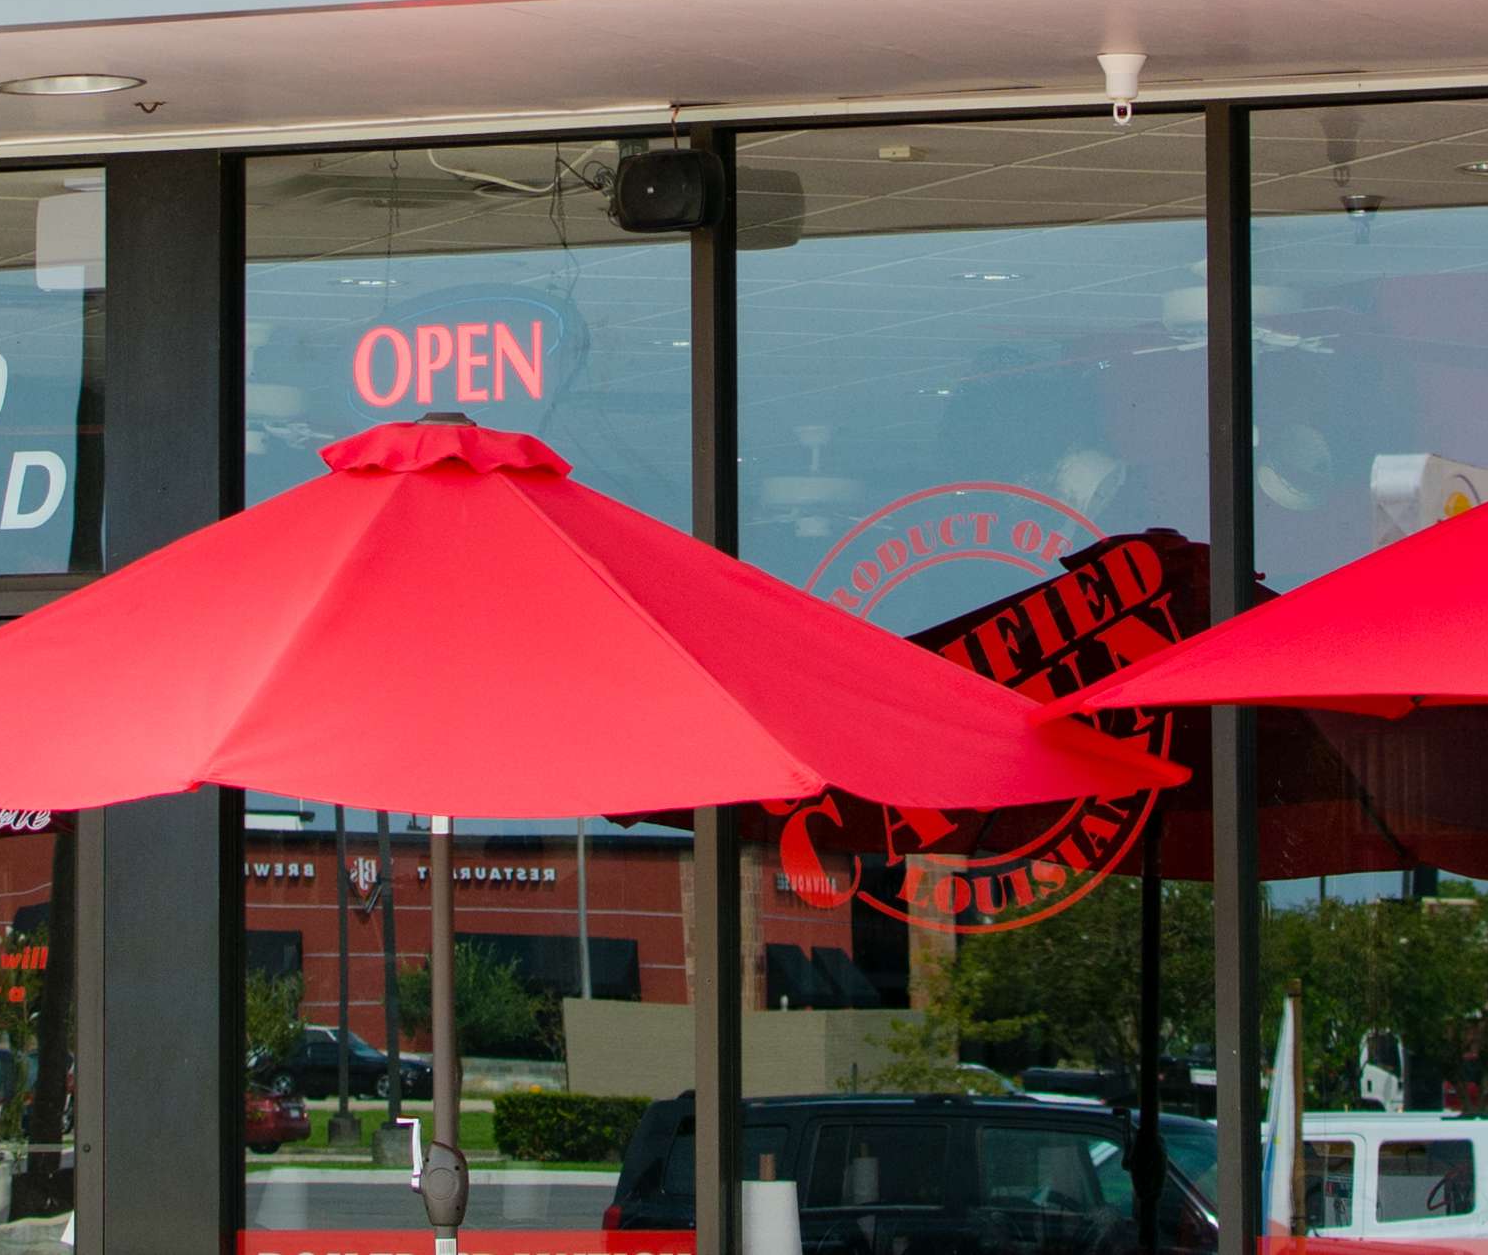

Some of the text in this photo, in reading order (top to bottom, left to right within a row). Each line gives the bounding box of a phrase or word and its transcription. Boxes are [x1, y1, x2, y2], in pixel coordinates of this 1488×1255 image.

[353, 320, 544, 408] OPEN
[0, 451, 67, 531] D
[828, 512, 998, 610] RODUCT
[0, 948, 49, 971] will
[8, 985, 27, 1003] a
